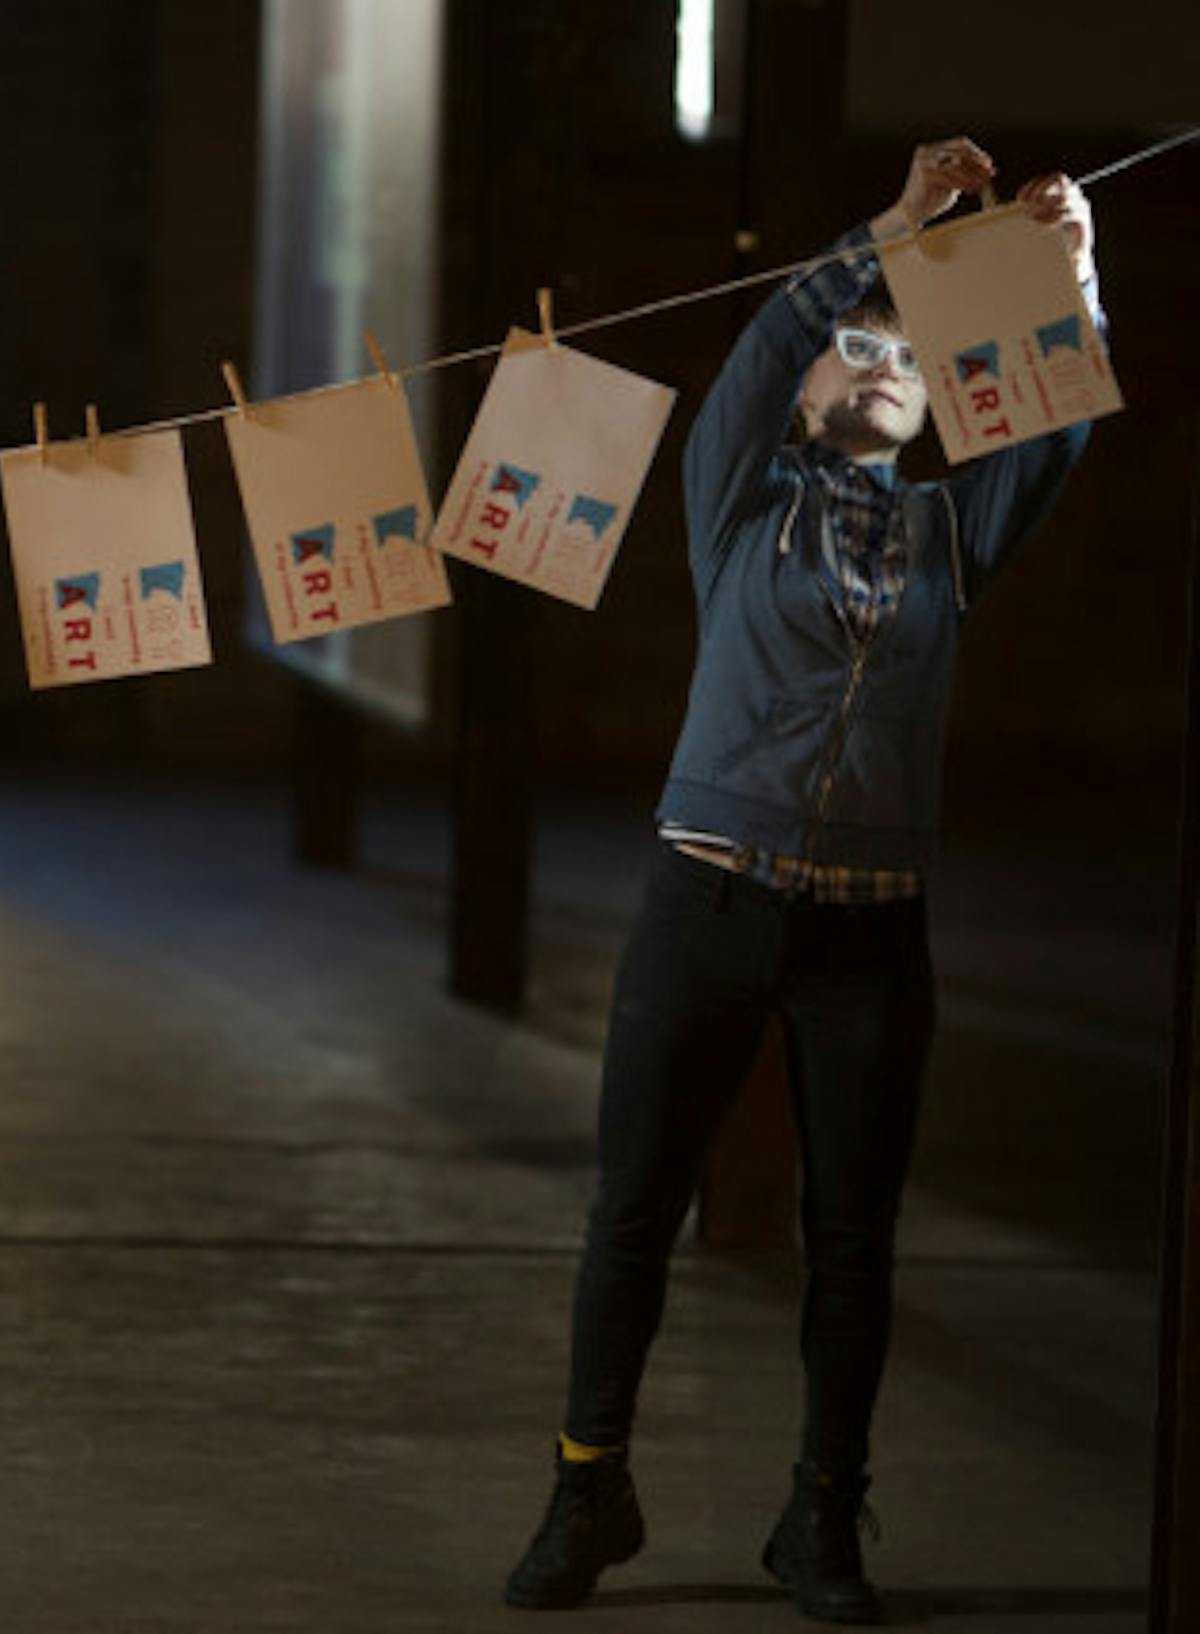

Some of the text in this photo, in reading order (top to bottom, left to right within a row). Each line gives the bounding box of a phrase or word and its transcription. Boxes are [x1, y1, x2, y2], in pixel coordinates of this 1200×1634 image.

[963, 357, 1012, 437] ART
[469, 468, 522, 560] ART
[296, 537, 339, 624] ART
[57, 583, 97, 671] ART
